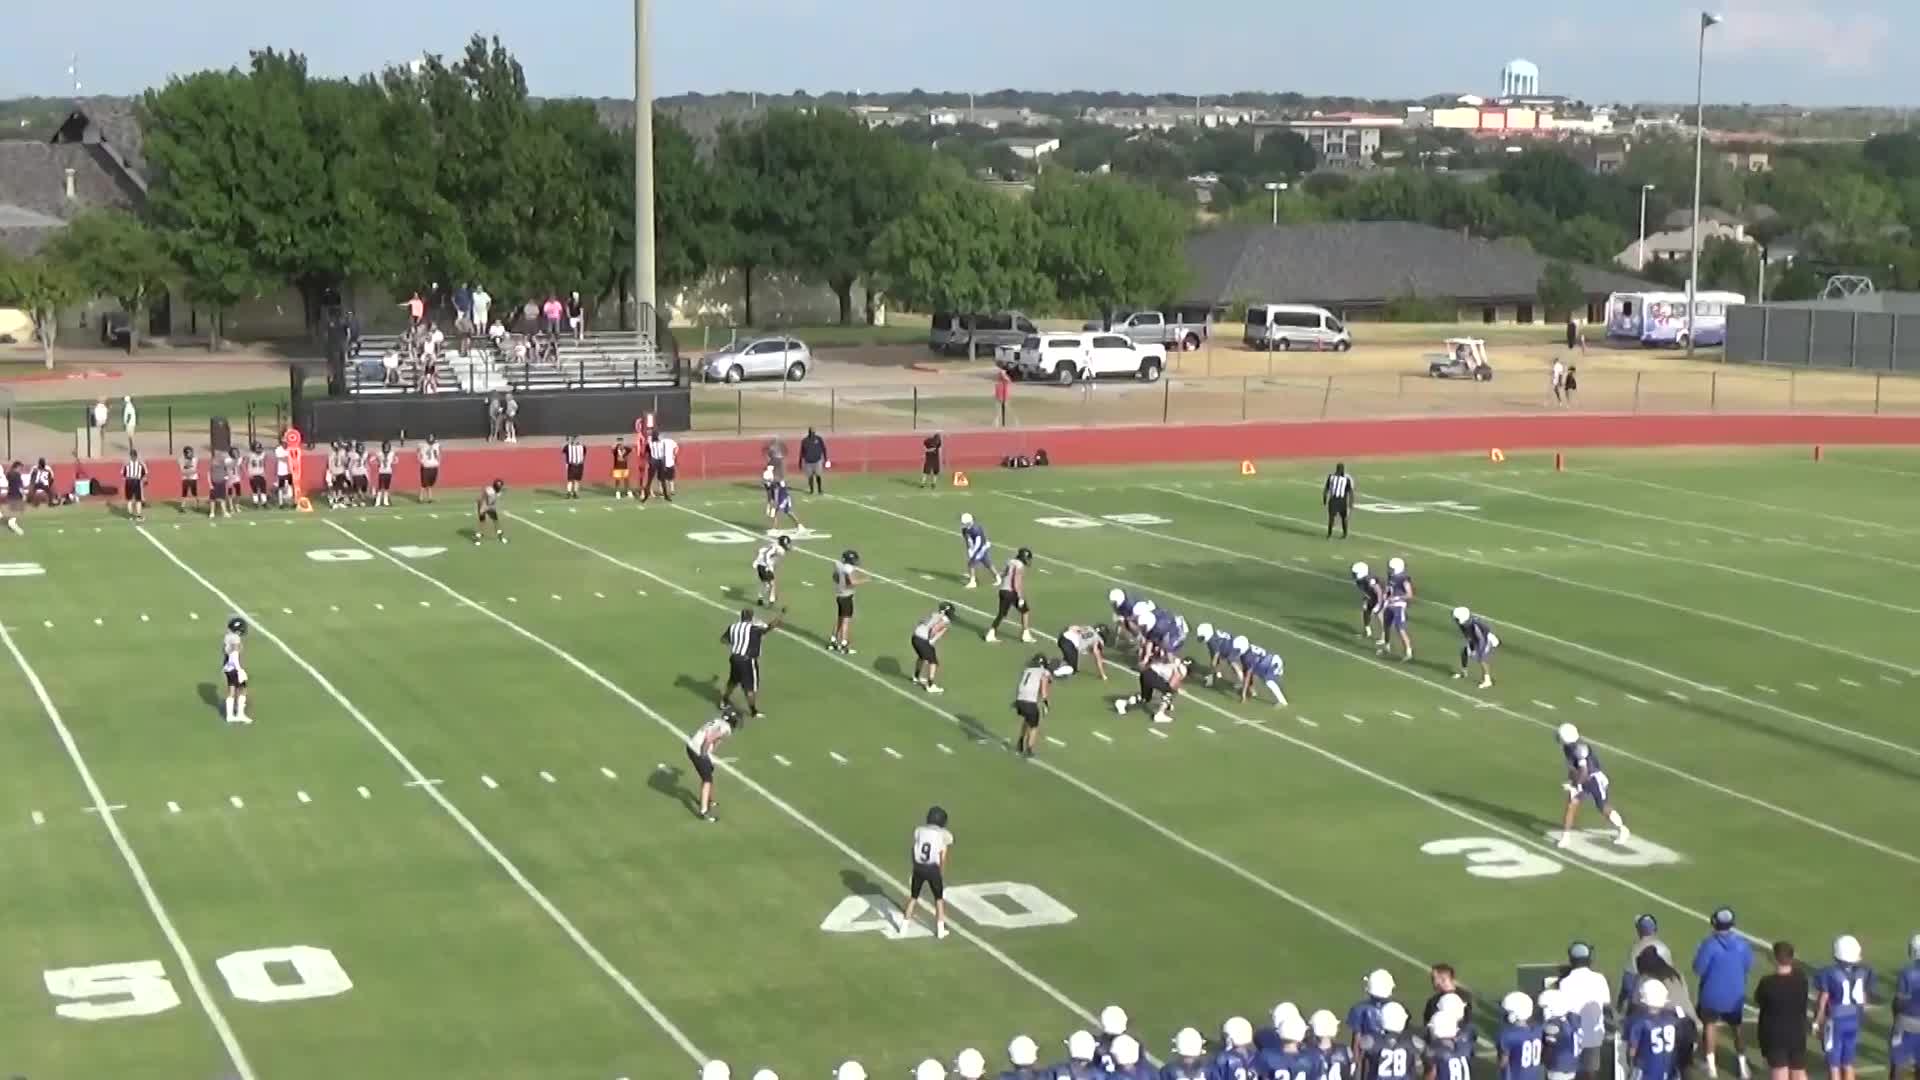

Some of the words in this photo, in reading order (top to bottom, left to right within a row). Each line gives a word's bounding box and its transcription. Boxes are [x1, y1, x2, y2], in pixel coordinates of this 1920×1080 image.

[920, 842, 931, 863] 9
[1420, 829, 1686, 879] 30
[820, 881, 1078, 939] 40
[43, 945, 354, 1021] 50
[1842, 978, 1864, 1006] 14
[1521, 1038, 1542, 1069] 80
[1651, 1024, 1676, 1054] 59
